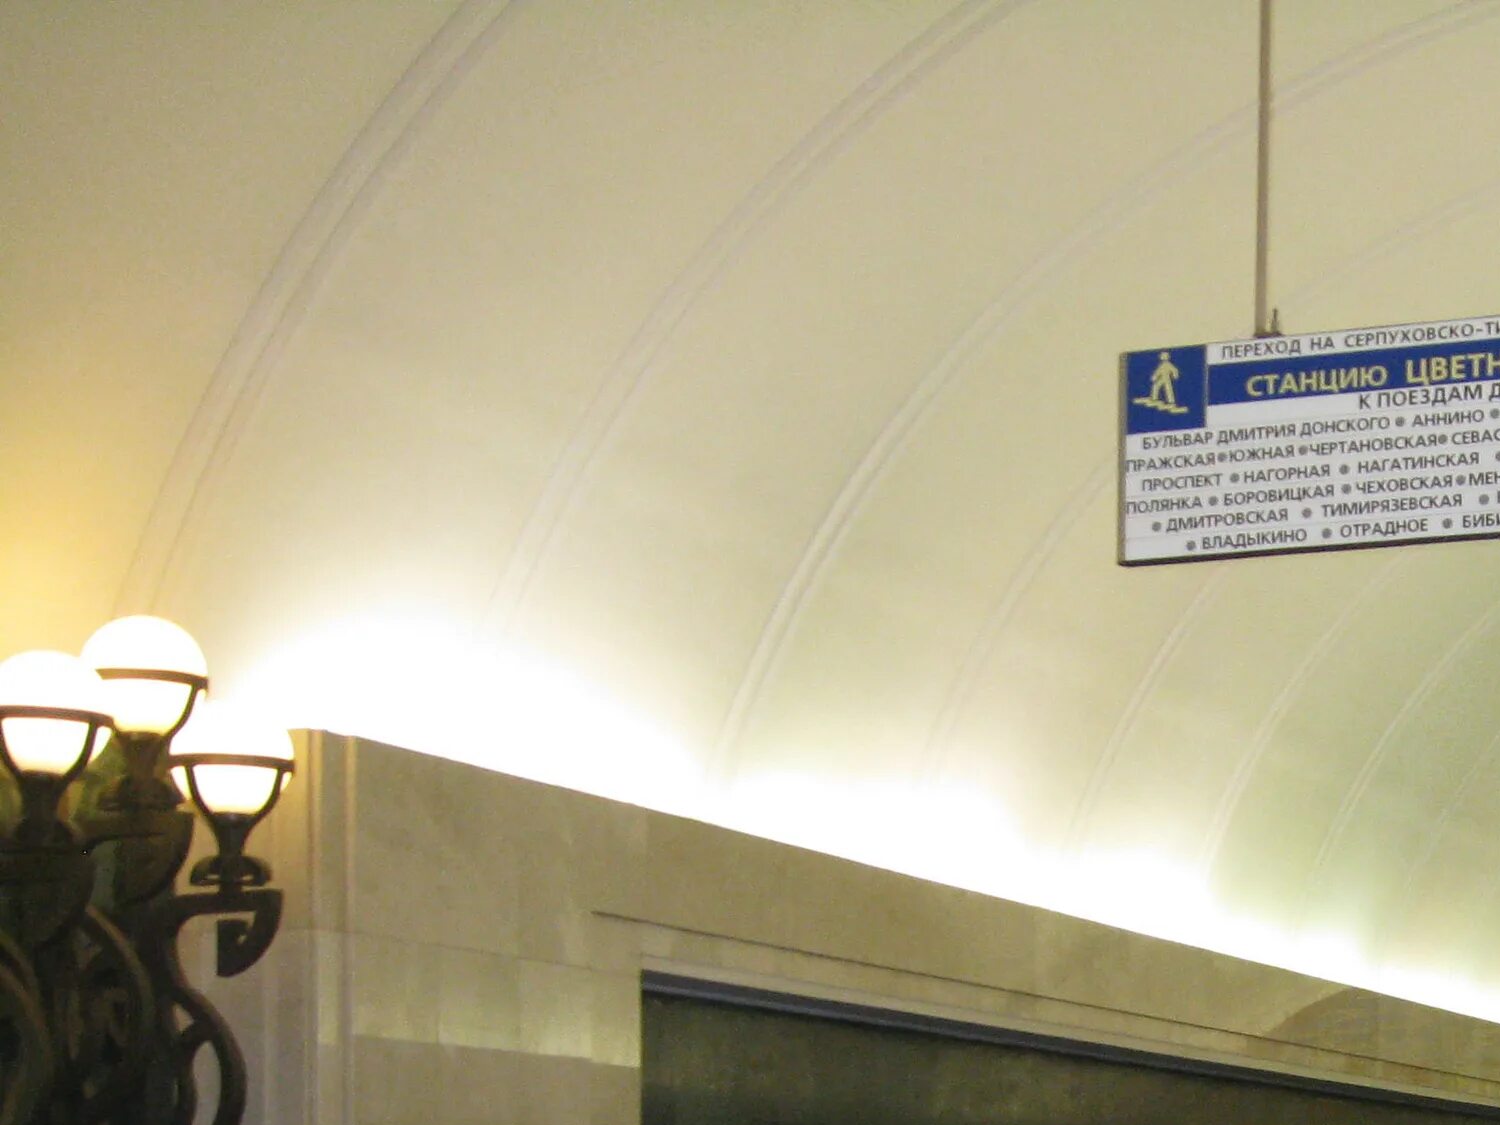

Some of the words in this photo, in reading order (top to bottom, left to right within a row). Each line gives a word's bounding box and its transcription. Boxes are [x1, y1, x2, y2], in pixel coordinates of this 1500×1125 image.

[1222, 339, 1301, 359] ПЕРЕХОД
[1310, 336, 1335, 351] НА
[1247, 365, 1388, 397] СТАНЦИЮ
[1359, 394, 1371, 409] К
[1378, 383, 1483, 408] ПОЕЗДАМ
[1143, 431, 1213, 450] БУЛЬВАР
[1217, 424, 1296, 445] ДМИТРИЯ
[1300, 416, 1390, 437] ДОНСКОГО
[1412, 408, 1485, 428] АННИНО
[1126, 452, 1216, 473] ПРАЖСКАЯ
[1229, 444, 1295, 463] ЮЖНАЯ
[1310, 433, 1438, 456] ЧЕРТАНОВСКАЯ
[1142, 473, 1224, 492] ПРОСПЕКТ
[1243, 464, 1331, 484] НАГОРНАЯ
[1358, 452, 1480, 474] НАГАТИНСКАЯ
[1126, 496, 1203, 515] ПОЛЯНКА
[1223, 484, 1335, 508] БОРОВИЦКАЯ
[1356, 474, 1453, 495] ЧЕХОВСКАЯ
[1166, 508, 1289, 533] ДМИТРОВСКАЯ
[1322, 493, 1463, 518] ТИМИРЯЗЕВСКАЯ
[1202, 528, 1307, 550] ВЛАДЫКИНО
[1340, 518, 1429, 538] ОТРАДНОЕ
